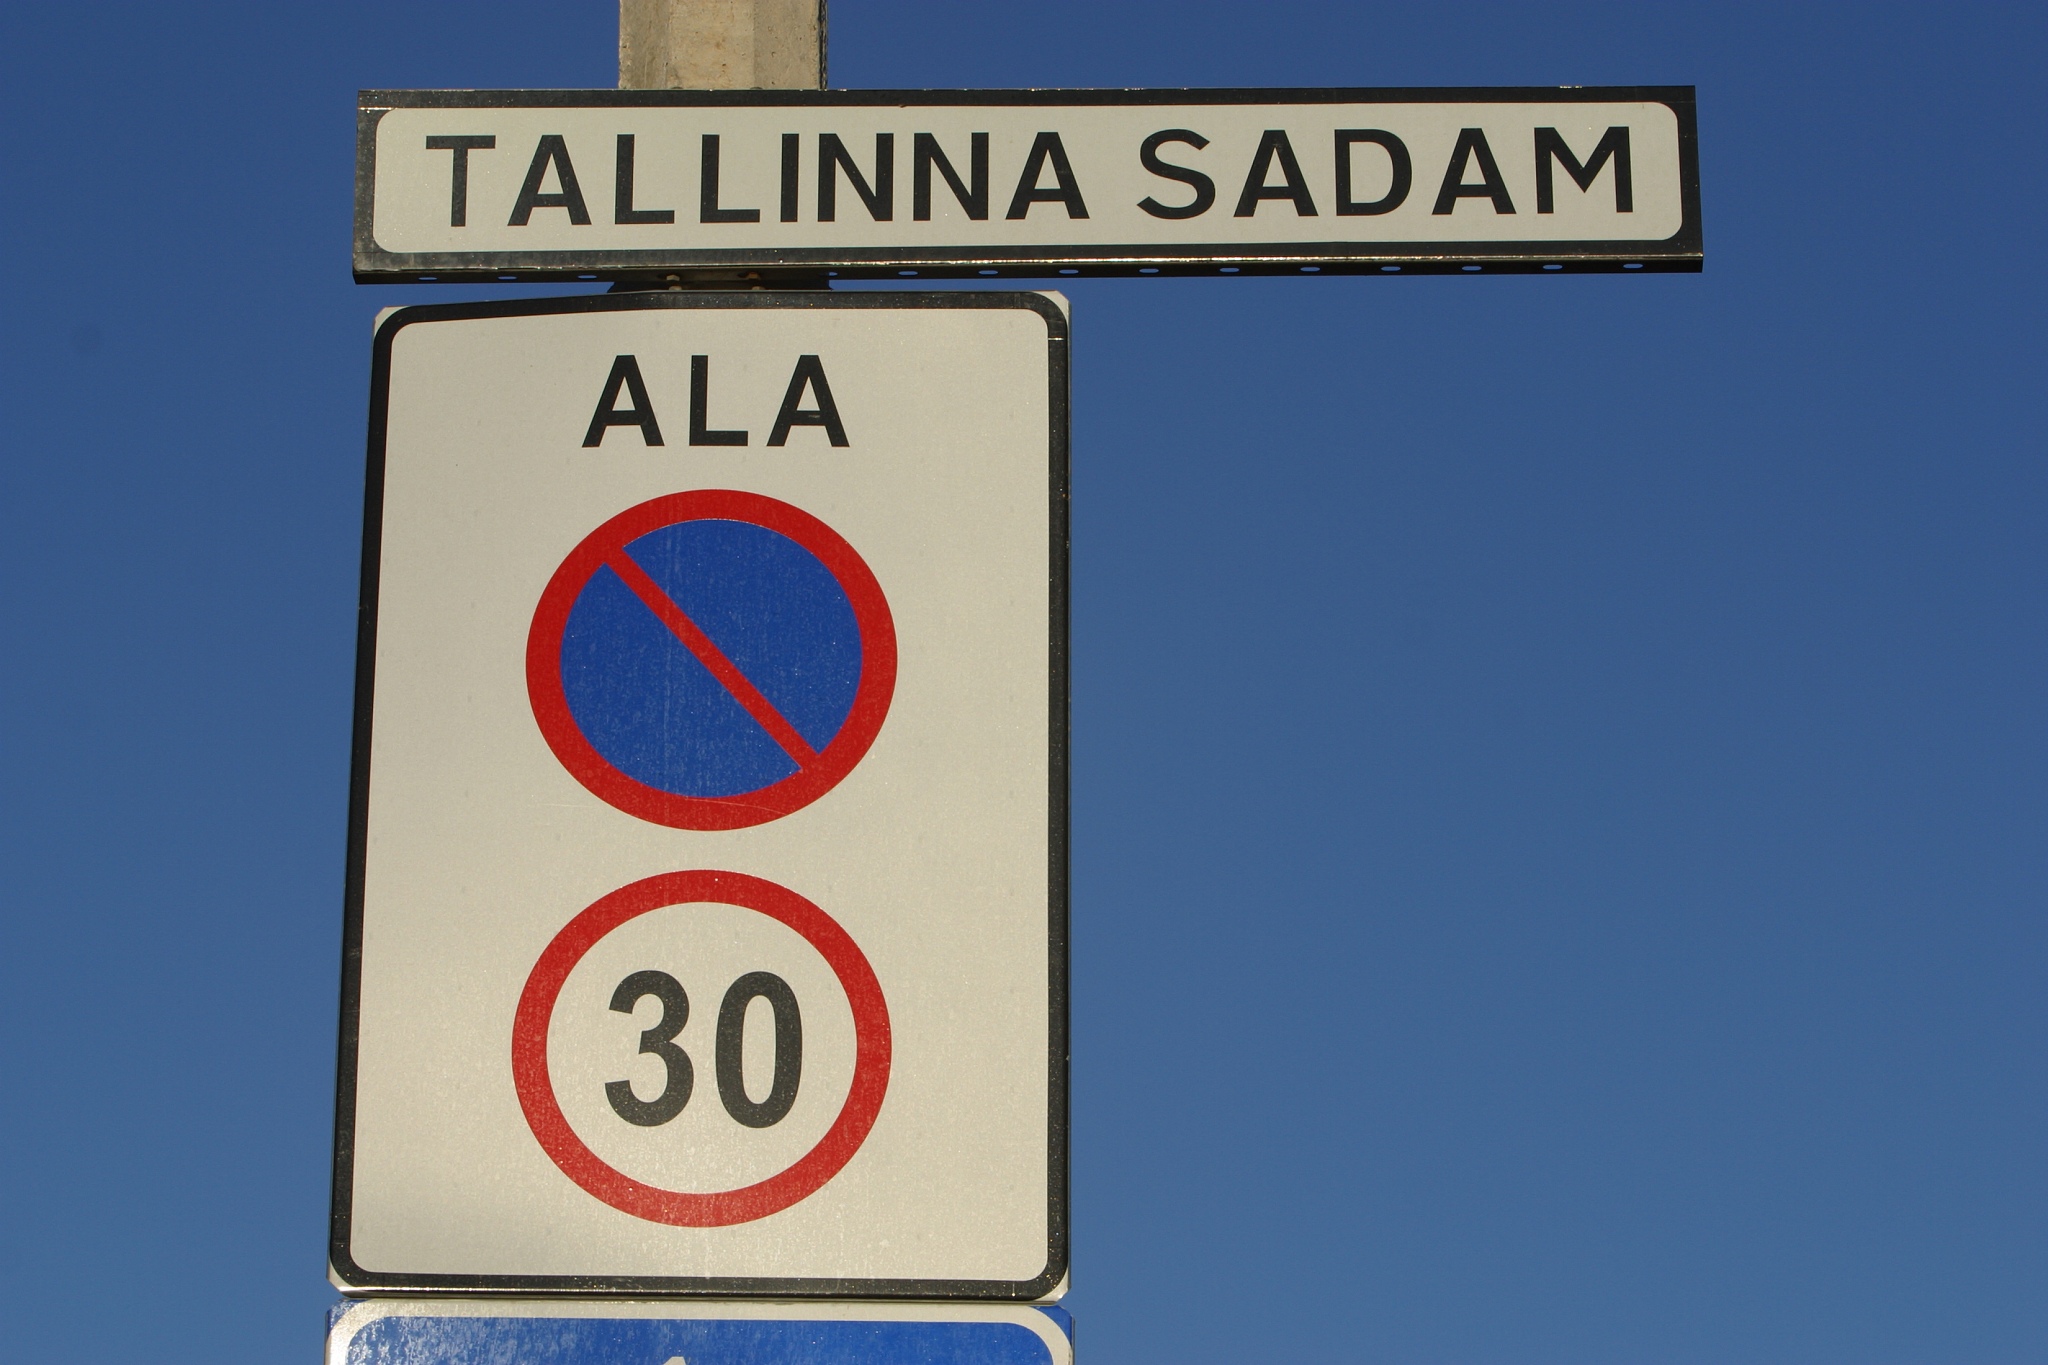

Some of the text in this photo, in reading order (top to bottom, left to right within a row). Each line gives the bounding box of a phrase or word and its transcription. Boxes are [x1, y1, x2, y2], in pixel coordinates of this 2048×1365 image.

[426, 127, 1633, 227] TALLINNA SADAM
[582, 355, 849, 447] ALA
[605, 971, 802, 1128] 30
